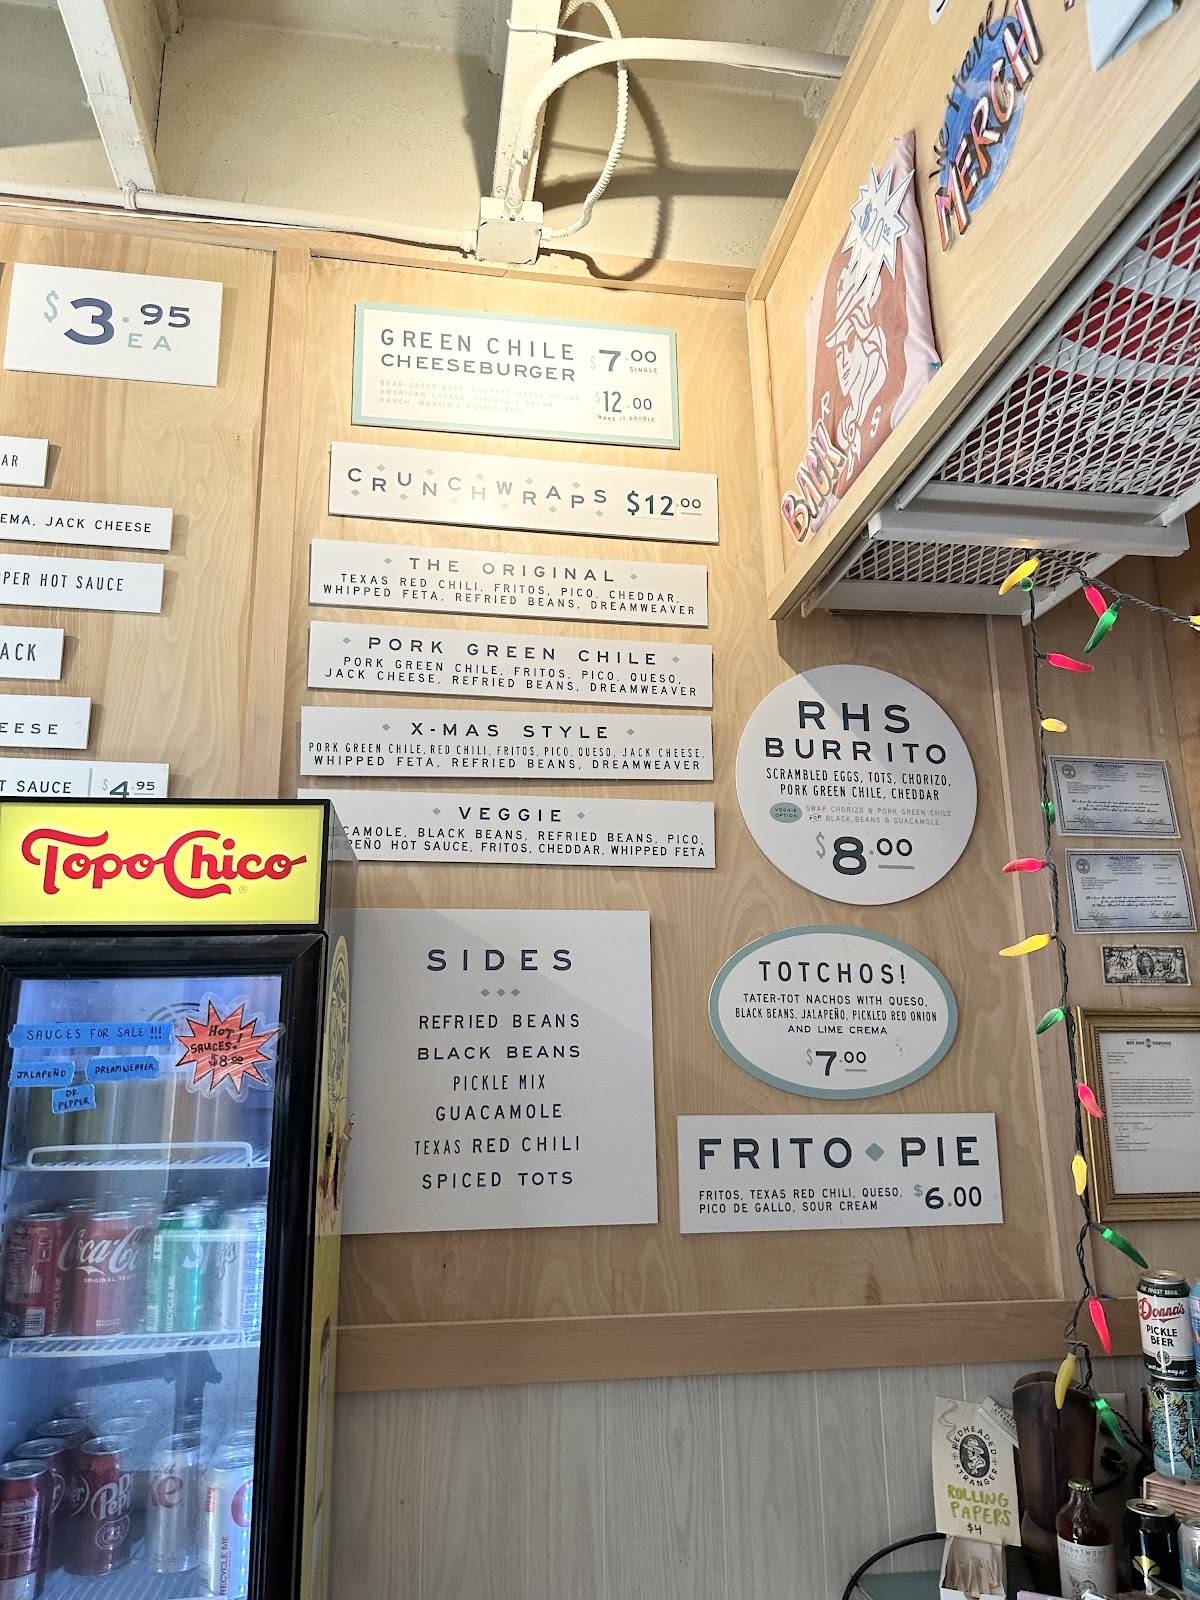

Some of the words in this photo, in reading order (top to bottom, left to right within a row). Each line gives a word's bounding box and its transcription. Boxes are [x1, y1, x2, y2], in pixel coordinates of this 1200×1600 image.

[934, 0, 1044, 252] MERCH
[43, 290, 191, 345] $3.95
[127, 333, 172, 352] EA
[381, 328, 472, 352] GREEN
[487, 337, 575, 361] CHILE
[381, 353, 575, 382] CHEESEBURGER
[782, 420, 847, 543] BACK
[347, 467, 608, 509] CRUNCHWRAPS
[626, 491, 702, 516] $12.00
[45, 516, 85, 529] JACK
[95, 520, 152, 533] CHEESE
[409, 557, 459, 573] THE
[482, 562, 614, 582] ORIGINAL
[40, 573, 68, 588] HOT
[76, 576, 124, 592] SAUCE
[341, 573, 388, 585] TEXAS
[400, 577, 427, 588] RED
[438, 579, 483, 592] CHILI,
[494, 583, 550, 596] FRITOS,
[561, 587, 598, 598] PICO,
[609, 590, 679, 604] CHEDDAR,
[323, 584, 391, 597] WHIPPED
[402, 589, 444, 601] FETA,
[455, 592, 517, 605] REFRIED
[528, 596, 580, 609] BEANS,
[591, 600, 694, 615] DREAMWEAVER
[368, 637, 443, 654] PORK
[467, 643, 555, 661] GREEN
[578, 650, 656, 666] CHILE
[343, 656, 383, 668] PORK
[395, 659, 443, 672] GREEN
[455, 663, 503, 676] CHILE,
[514, 666, 571, 679] FRITOS,
[582, 670, 619, 682] PICO,
[630, 672, 681, 685] QUESO,
[325, 668, 365, 679] JACK
[377, 670, 440, 685] CHEESE,
[452, 675, 515, 688] REFRIED
[526, 679, 579, 692] BEANS,
[590, 682, 696, 696] DREAMWEAVER
[798, 700, 910, 734] RHS
[411, 722, 499, 737] X-MAS
[523, 725, 607, 739] STYLE
[309, 742, 338, 752] PORK
[345, 742, 381, 753] GREEN
[388, 743, 426, 755] CHILE,
[430, 744, 450, 755] RED
[456, 745, 491, 756] CHILI,
[497, 746, 539, 757] FRITOS,
[544, 746, 573, 757] PICO,
[578, 746, 616, 757] QUESO,
[622, 747, 650, 757] JACK
[658, 748, 704, 758] CHEESE,
[765, 737, 946, 765] BURRITO
[314, 755, 385, 766] WHIPPED
[397, 756, 440, 768] FETA,
[452, 757, 516, 768] REFRIED
[527, 759, 581, 770] BEANS,
[592, 759, 699, 770] DREAMWEAVER
[766, 767, 828, 781] SCRAMBLED
[834, 770, 863, 783] EGGS,
[868, 772, 896, 785] TOTS,
[902, 773, 951, 787] CHORIZO,
[16, 781, 72, 794] SAUCE
[101, 778, 155, 798] $4.95
[780, 783, 808, 796] PORK
[813, 785, 846, 797] GREEN
[852, 786, 886, 800] CHILE,
[891, 788, 939, 800] CHEDDAR
[458, 806, 561, 822] VEGGIE
[901, 808, 926, 816] GREEN
[418, 827, 465, 839] BLACK
[475, 829, 528, 841] BEANS,
[538, 830, 597, 842] REFRIED
[607, 832, 658, 844] BEANS,
[667, 834, 704, 845] PICO,
[391, 840, 417, 850] HOT
[424, 840, 472, 853] SAUCE,
[481, 842, 532, 854] FRITOS,
[538, 843, 604, 856] CHEDDAR,
[610, 845, 667, 856] WHIPPED
[675, 847, 705, 857] FETA
[816, 832, 913, 875] $8.00
[21, 828, 157, 895] Topo
[163, 829, 308, 899] Chico
[427, 949, 572, 972] SIDES
[758, 961, 905, 984] TOTCHOS!
[743, 993, 800, 1004] TATER-TOT
[806, 994, 851, 1005] NACHOS
[856, 995, 882, 1005] WITH
[888, 996, 928, 1007] QUESO,
[419, 1014, 498, 1030] REFRIED
[513, 1013, 579, 1028] BEANS
[735, 1007, 763, 1018] BLACK
[766, 1008, 797, 1019] BEANS,
[801, 1007, 848, 1020] JALAPEÑO,
[852, 1010, 887, 1021] PICKLED
[891, 1010, 907, 1021] RED
[910, 1011, 937, 1022] ONION
[26, 1028, 81, 1040] SAUCES
[90, 1028, 109, 1039] FOR
[117, 1027, 145, 1039] SALE
[787, 1025, 811, 1033] AND
[817, 1025, 843, 1034] LIME
[849, 1026, 888, 1035] CREMA
[418, 1046, 491, 1060] BLACK
[507, 1045, 580, 1059] BEANS
[94, 1064, 154, 1075] DREAMWEAVER
[806, 1049, 867, 1076] $7.00
[16, 1067, 67, 1079] JALAPEÑO
[453, 1074, 508, 1091] PICKLE
[519, 1074, 545, 1090] MIX
[58, 1097, 89, 1110] PEPPER
[436, 1103, 562, 1121] GUACAMOLE
[415, 1139, 460, 1155] TEXAS
[473, 1137, 510, 1154] RED
[521, 1135, 579, 1152] CHILI
[698, 1137, 852, 1170] FRITO
[900, 1136, 980, 1167] PIE
[422, 1172, 501, 1190] SPICED
[518, 1171, 573, 1186] TOTS
[699, 1189, 743, 1201] FRITOS,
[750, 1189, 786, 1199] TEXAS
[793, 1188, 815, 1199] RED
[822, 1188, 855, 1198] CHILI,
[862, 1187, 902, 1198] QUESO,
[913, 1184, 982, 1209] $6.00
[699, 1203, 726, 1214] PICO
[733, 1203, 748, 1213] DE
[755, 1202, 795, 1213] GALLO,
[802, 1201, 832, 1212] SOUR
[839, 1200, 878, 1211] CREAM
[1146, 1324, 1178, 1338] PICKLE
[1150, 1335, 1175, 1348] BEER
[947, 1484, 1009, 1507] ROLLING
[950, 1502, 1011, 1527] PAPERS
[966, 1523, 982, 1535] $4
